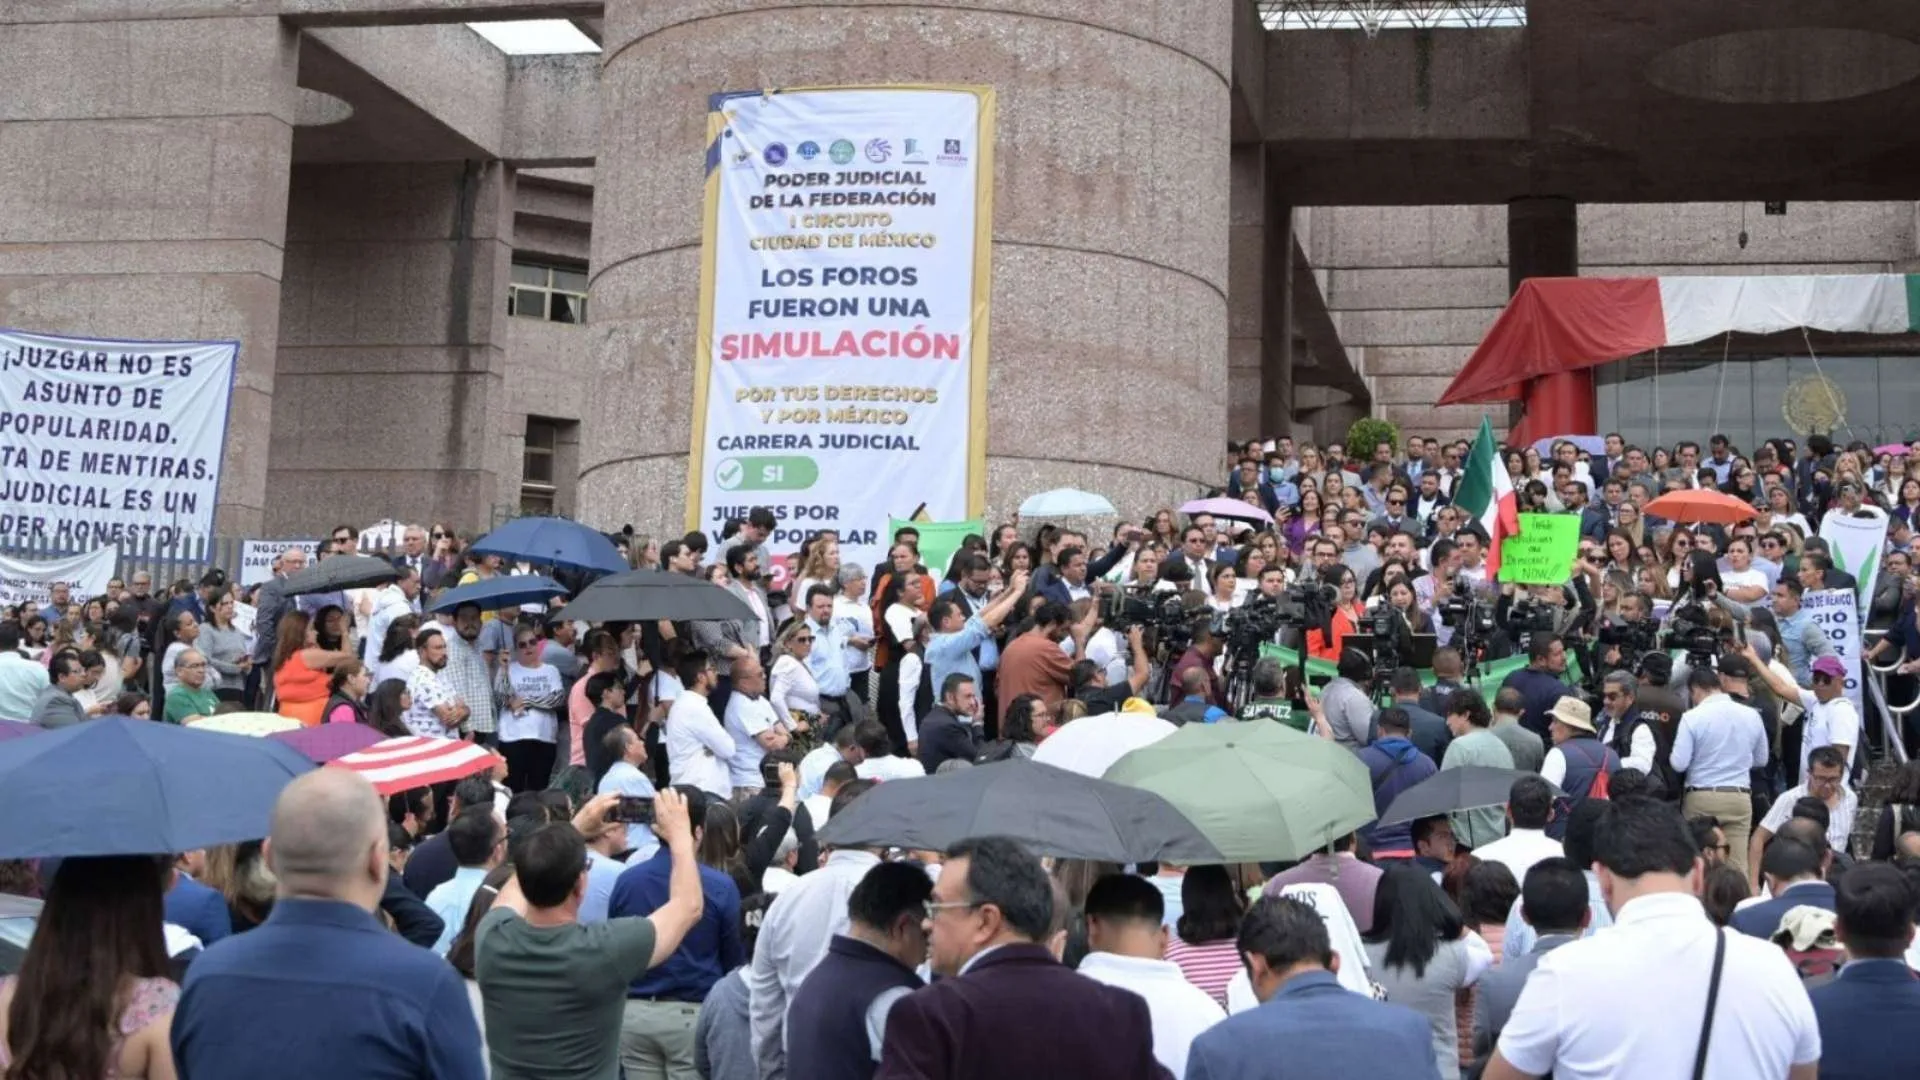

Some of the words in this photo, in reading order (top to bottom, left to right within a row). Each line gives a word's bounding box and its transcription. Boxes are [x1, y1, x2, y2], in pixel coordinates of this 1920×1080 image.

[764, 172, 830, 188] PODER
[836, 171, 926, 186] JUDICIAL
[750, 195, 774, 209] DE
[779, 194, 804, 208] LA
[809, 187, 936, 207] FEDERACIÓN
[790, 213, 797, 228] I
[801, 211, 893, 228] CIRCUITO
[750, 235, 823, 251] CIUDAD
[827, 233, 854, 248] DE
[858, 229, 937, 249] MÉXICO
[761, 268, 814, 288] LOS
[822, 266, 918, 287] FOROS
[748, 297, 861, 319] FUERON
[868, 297, 931, 318] UNA
[720, 324, 960, 361] SIMULACIÓN
[3, 346, 109, 374] ¡JUZGAR
[119, 354, 152, 375] NO
[163, 355, 194, 377] ES
[23, 381, 122, 407] ASUNTO
[132, 388, 164, 410] DE
[735, 387, 776, 403] POR
[781, 386, 819, 401] TUS
[824, 384, 939, 404] DERECHOS
[760, 409, 773, 424] Y
[778, 408, 821, 424] POR
[826, 404, 909, 425] MÉXICO
[0, 412, 178, 445] POPULARIDAD.
[717, 434, 813, 451] CARRERA
[819, 433, 921, 450] JUDICIAL
[2, 446, 29, 469] TA
[40, 449, 71, 472] DE
[80, 451, 215, 481] MENTIRAS.
[762, 465, 785, 483] SI
[0, 480, 112, 509] JUDICIAL
[123, 490, 153, 512] ES
[164, 491, 198, 515] UN
[712, 505, 787, 521] JUES
[794, 505, 840, 520] POR
[0, 514, 46, 538] DER
[57, 518, 183, 549] HONESTO!
[773, 529, 878, 545] POPLAR
[253, 544, 319, 554] NOSOOS
